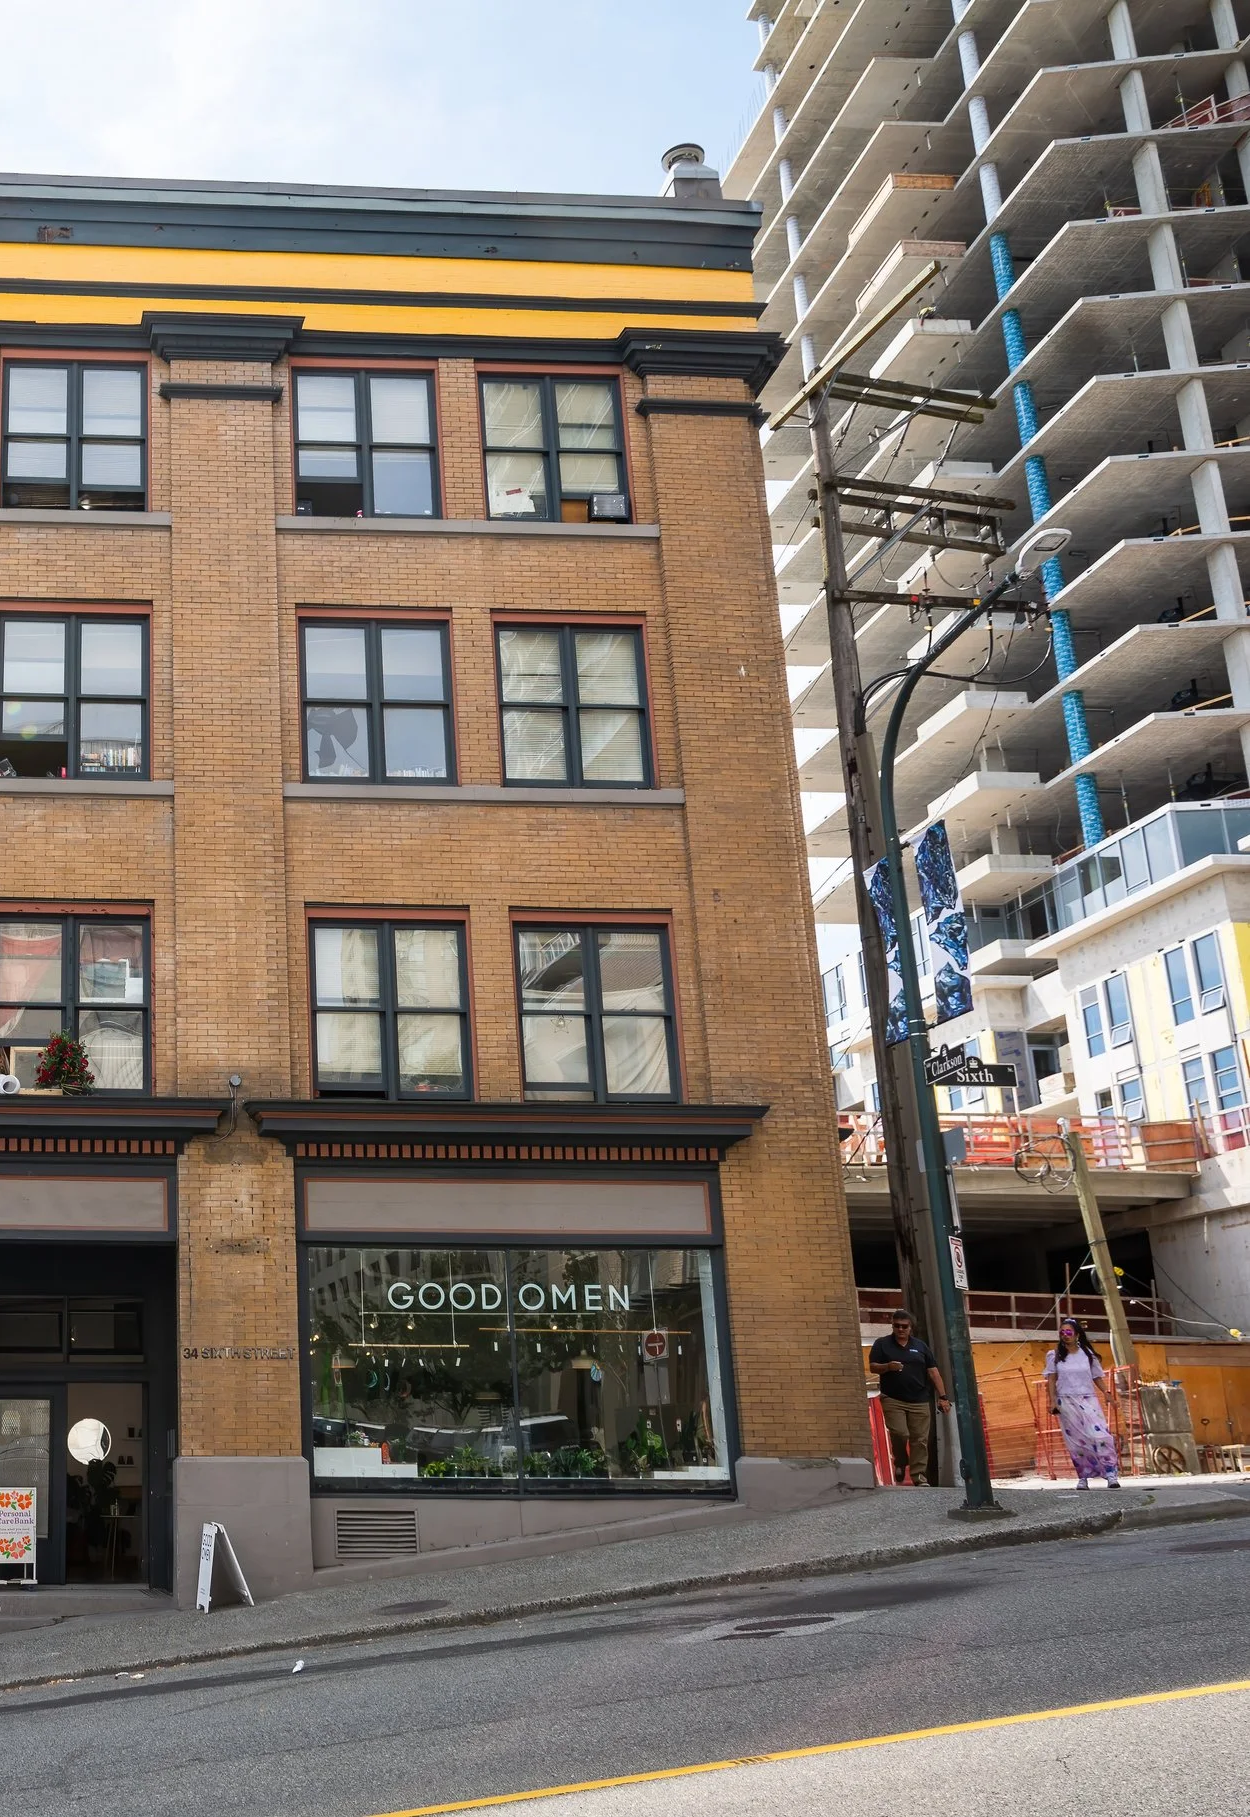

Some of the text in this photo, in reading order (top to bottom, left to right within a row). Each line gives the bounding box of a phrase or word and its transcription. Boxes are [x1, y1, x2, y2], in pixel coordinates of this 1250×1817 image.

[931, 1054, 963, 1077] Clarkson
[956, 1067, 994, 1083] Sixth
[387, 1282, 630, 1311] GOOD OMEN
[183, 1347, 295, 1360] 34 SIXTH STREET
